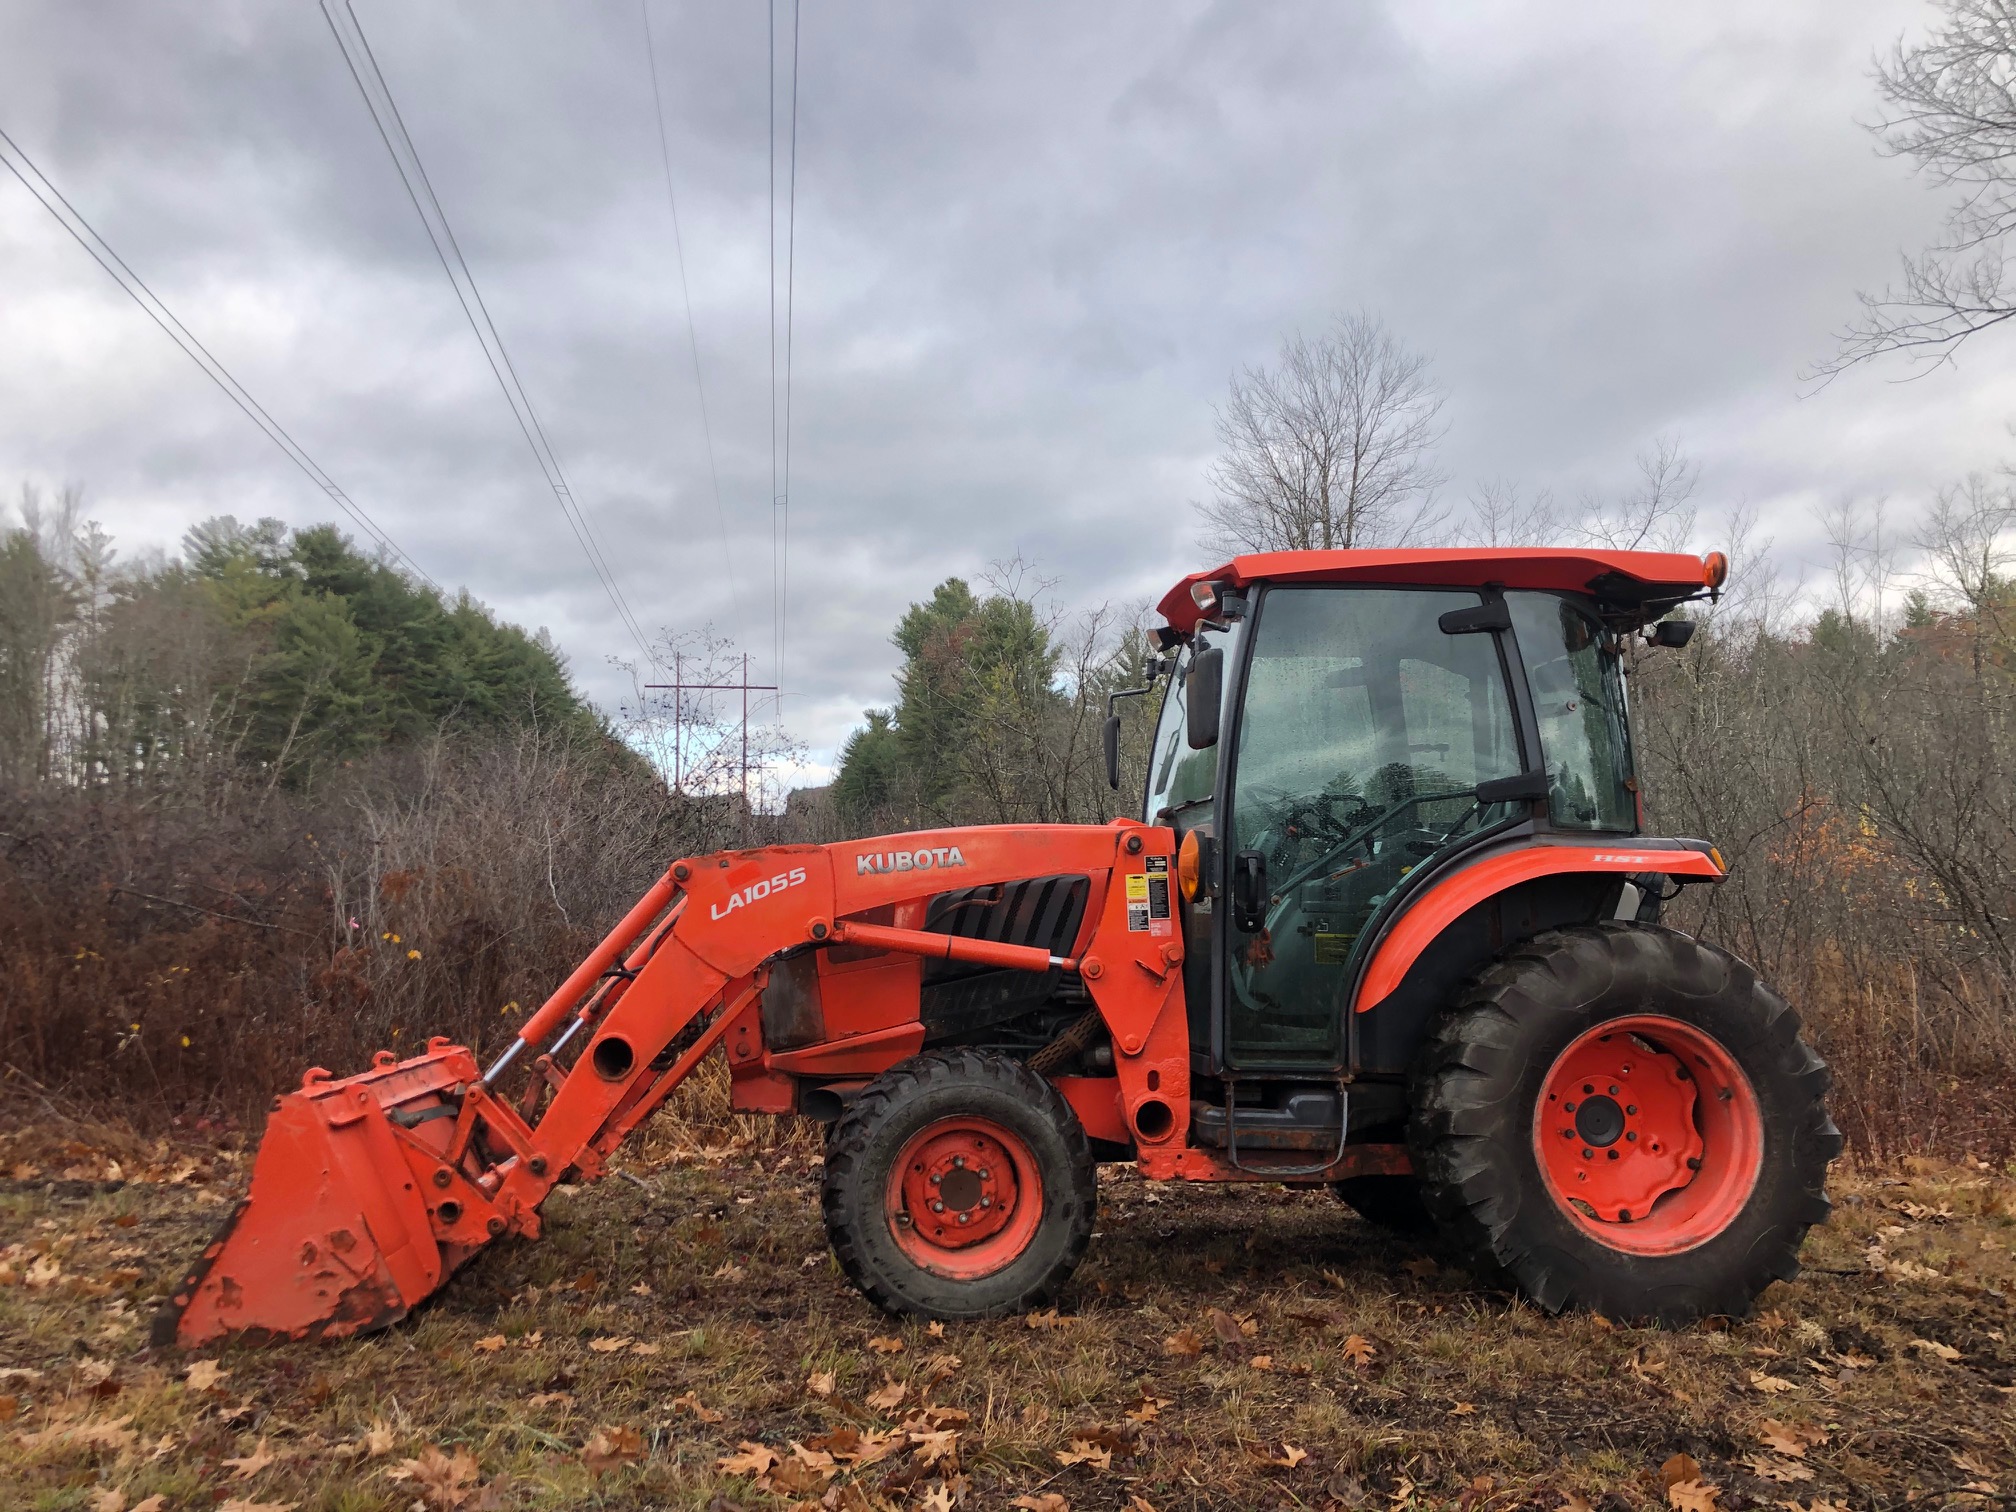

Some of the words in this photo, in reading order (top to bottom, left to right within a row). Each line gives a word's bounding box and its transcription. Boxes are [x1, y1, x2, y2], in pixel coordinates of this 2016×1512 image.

[857, 846, 967, 876] KUBOTA
[1592, 854, 1649, 863] HST
[710, 867, 807, 921] LA1055
